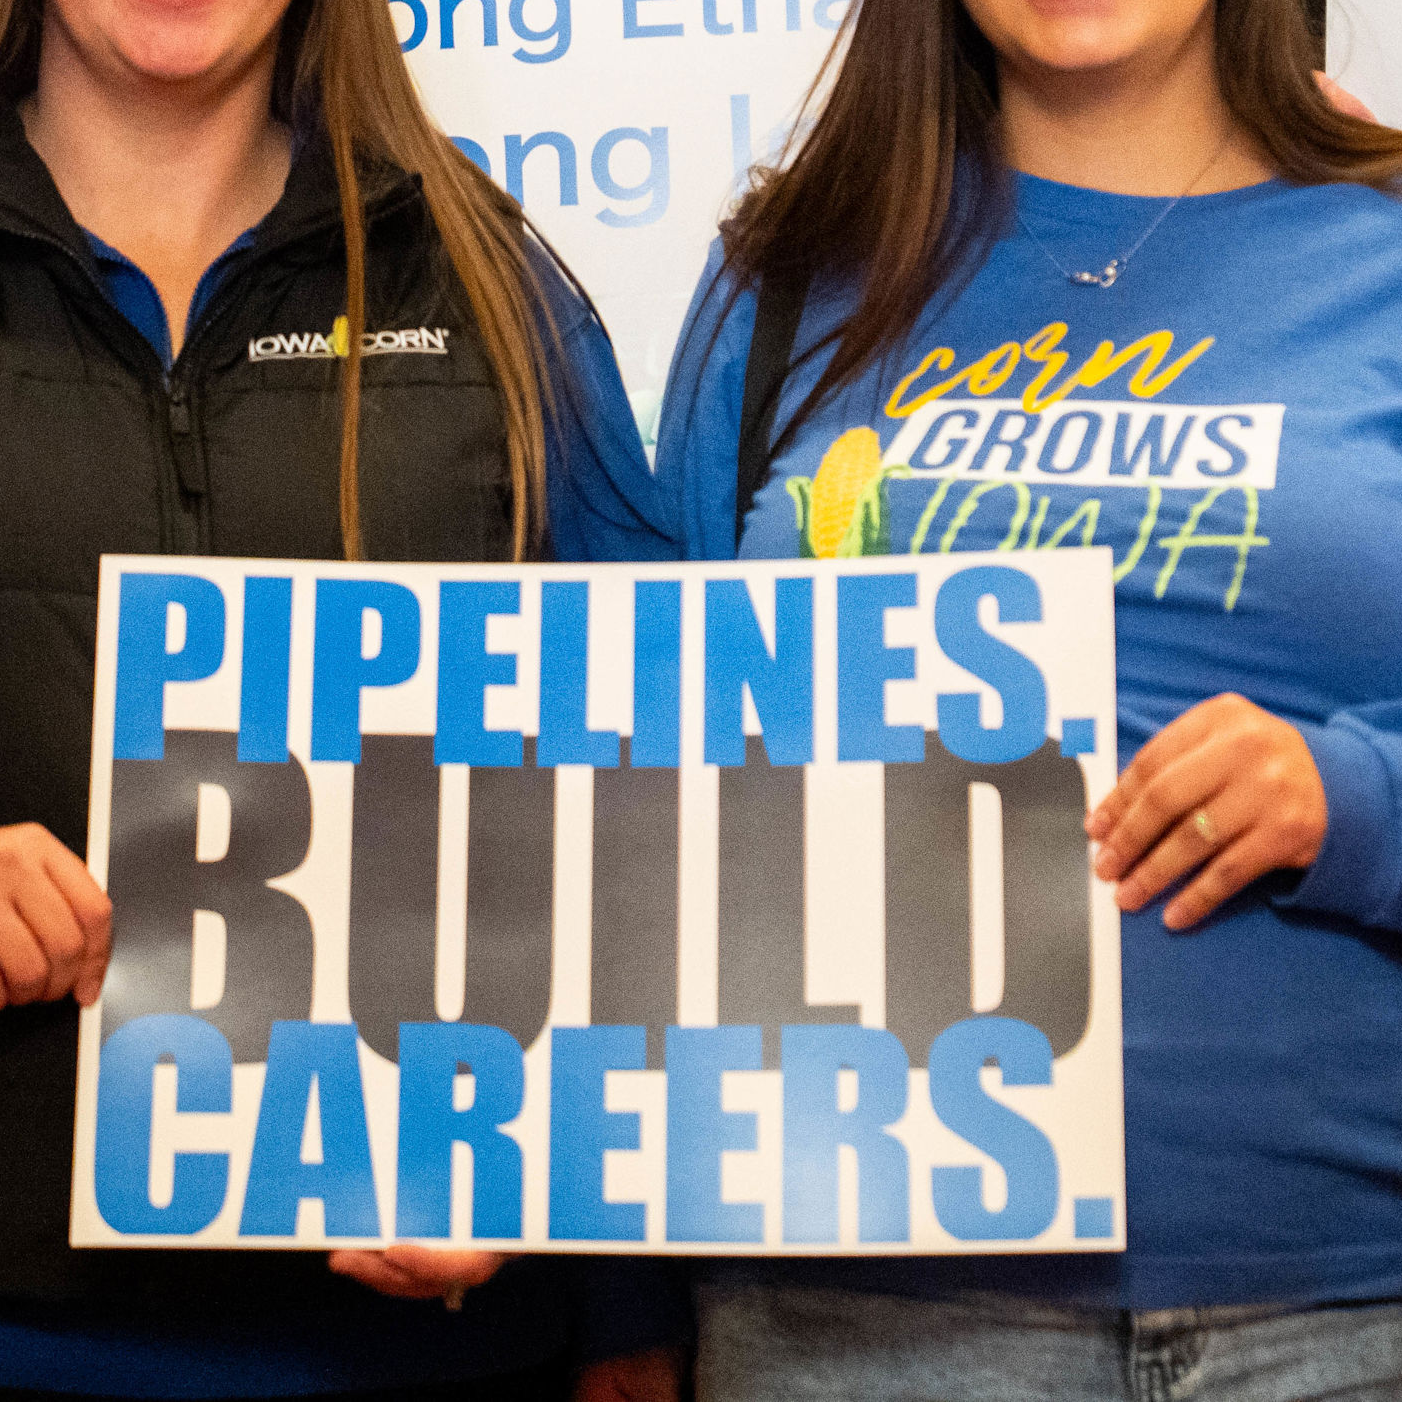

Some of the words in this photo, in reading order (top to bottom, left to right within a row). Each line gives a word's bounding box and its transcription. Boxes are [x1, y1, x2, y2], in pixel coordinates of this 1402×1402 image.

[248, 331, 329, 359] IOWA
[884, 320, 1216, 419] corn
[907, 407, 1256, 479] GROWS
[111, 565, 1098, 769] PIPELINES.
[102, 728, 1095, 1070] BUILD
[93, 1011, 1115, 1244] CAREERS.
